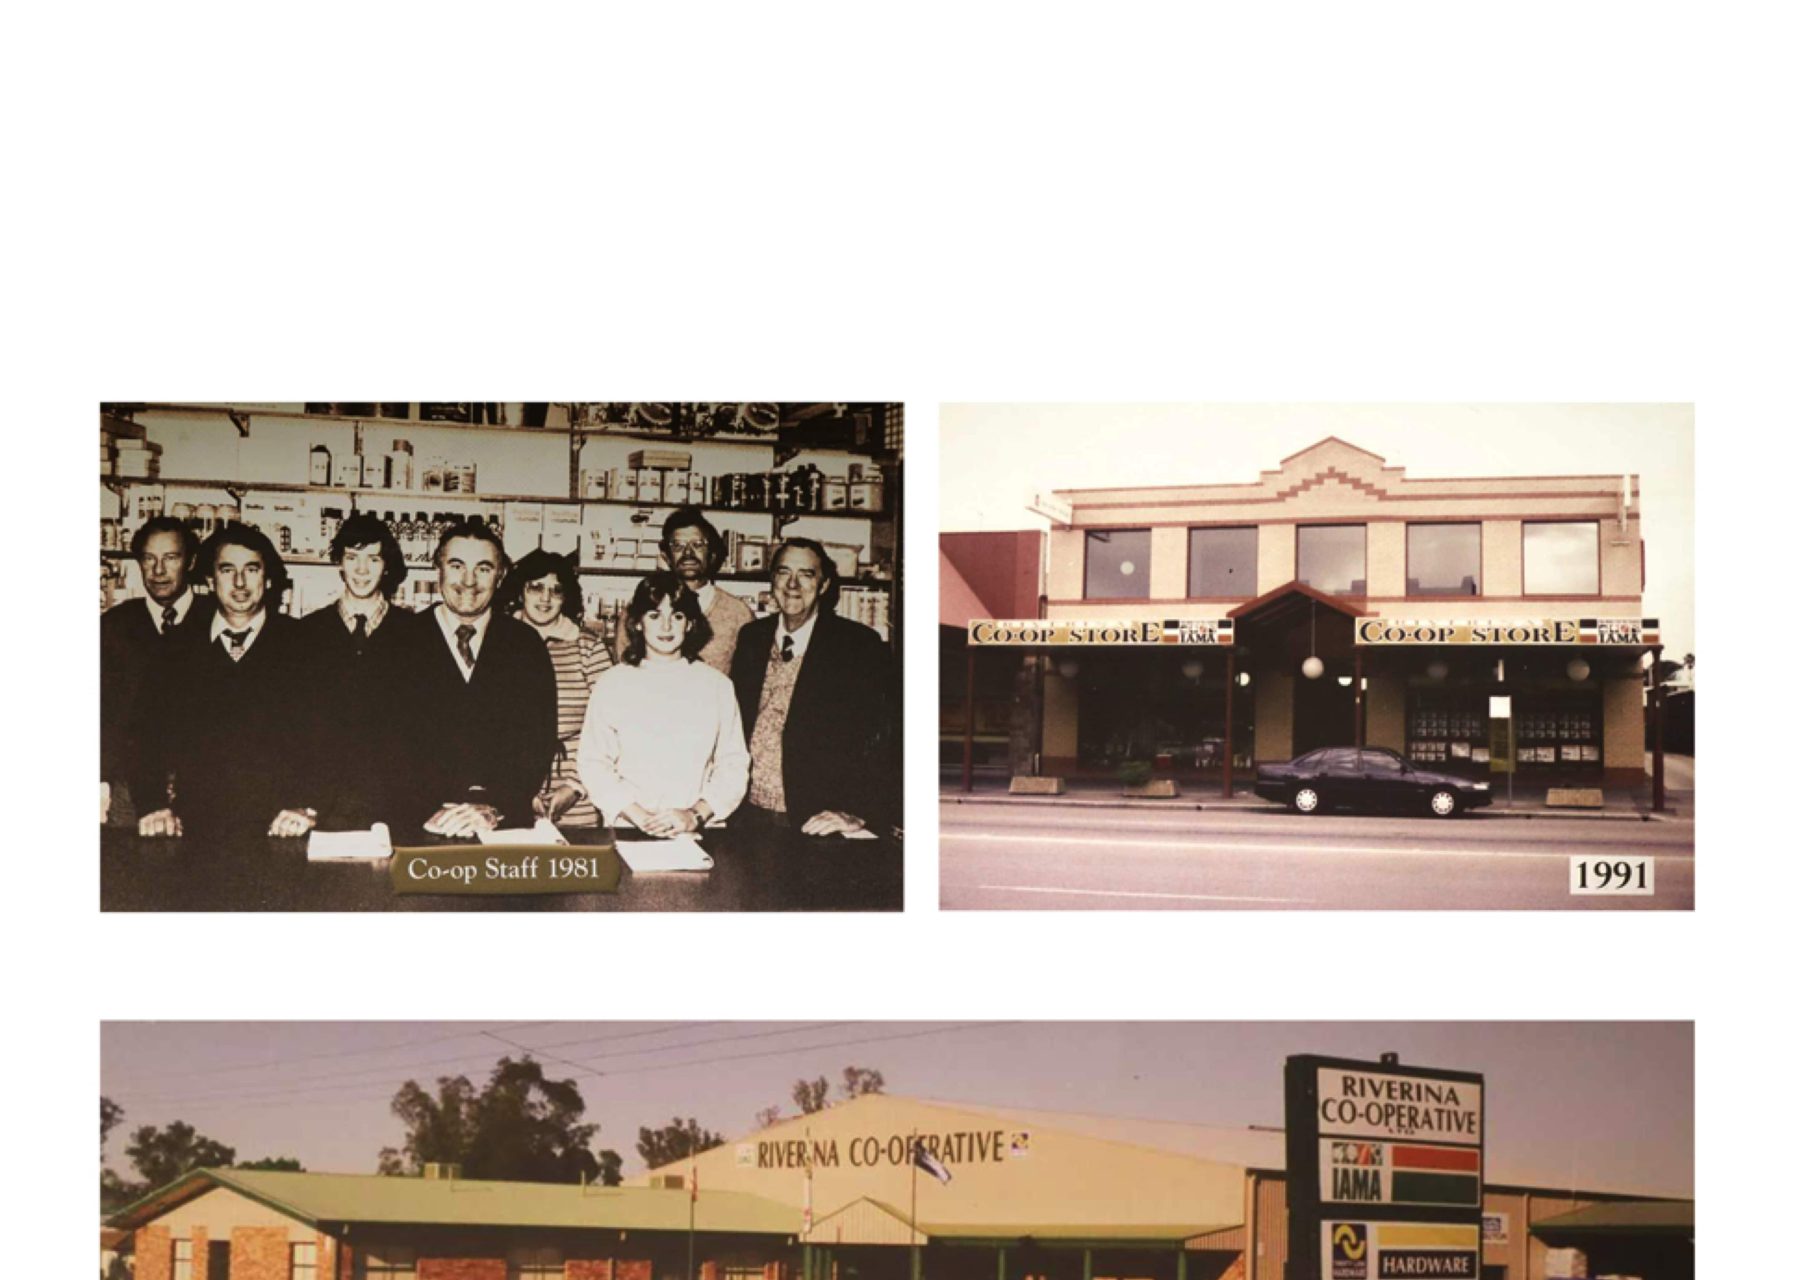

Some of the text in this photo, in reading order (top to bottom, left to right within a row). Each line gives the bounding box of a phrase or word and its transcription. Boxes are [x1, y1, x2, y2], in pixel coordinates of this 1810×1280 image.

[1070, 622, 1160, 643] STORE
[1472, 620, 1575, 643] STORE
[1342, 1075, 1460, 1106] RIVERINA
[1321, 1098, 1477, 1135] CO-OPERATIVE
[757, 1139, 840, 1169] RIVERNA
[1332, 1167, 1382, 1201] IAMA
[1382, 1256, 1469, 1274] HARDWARE
